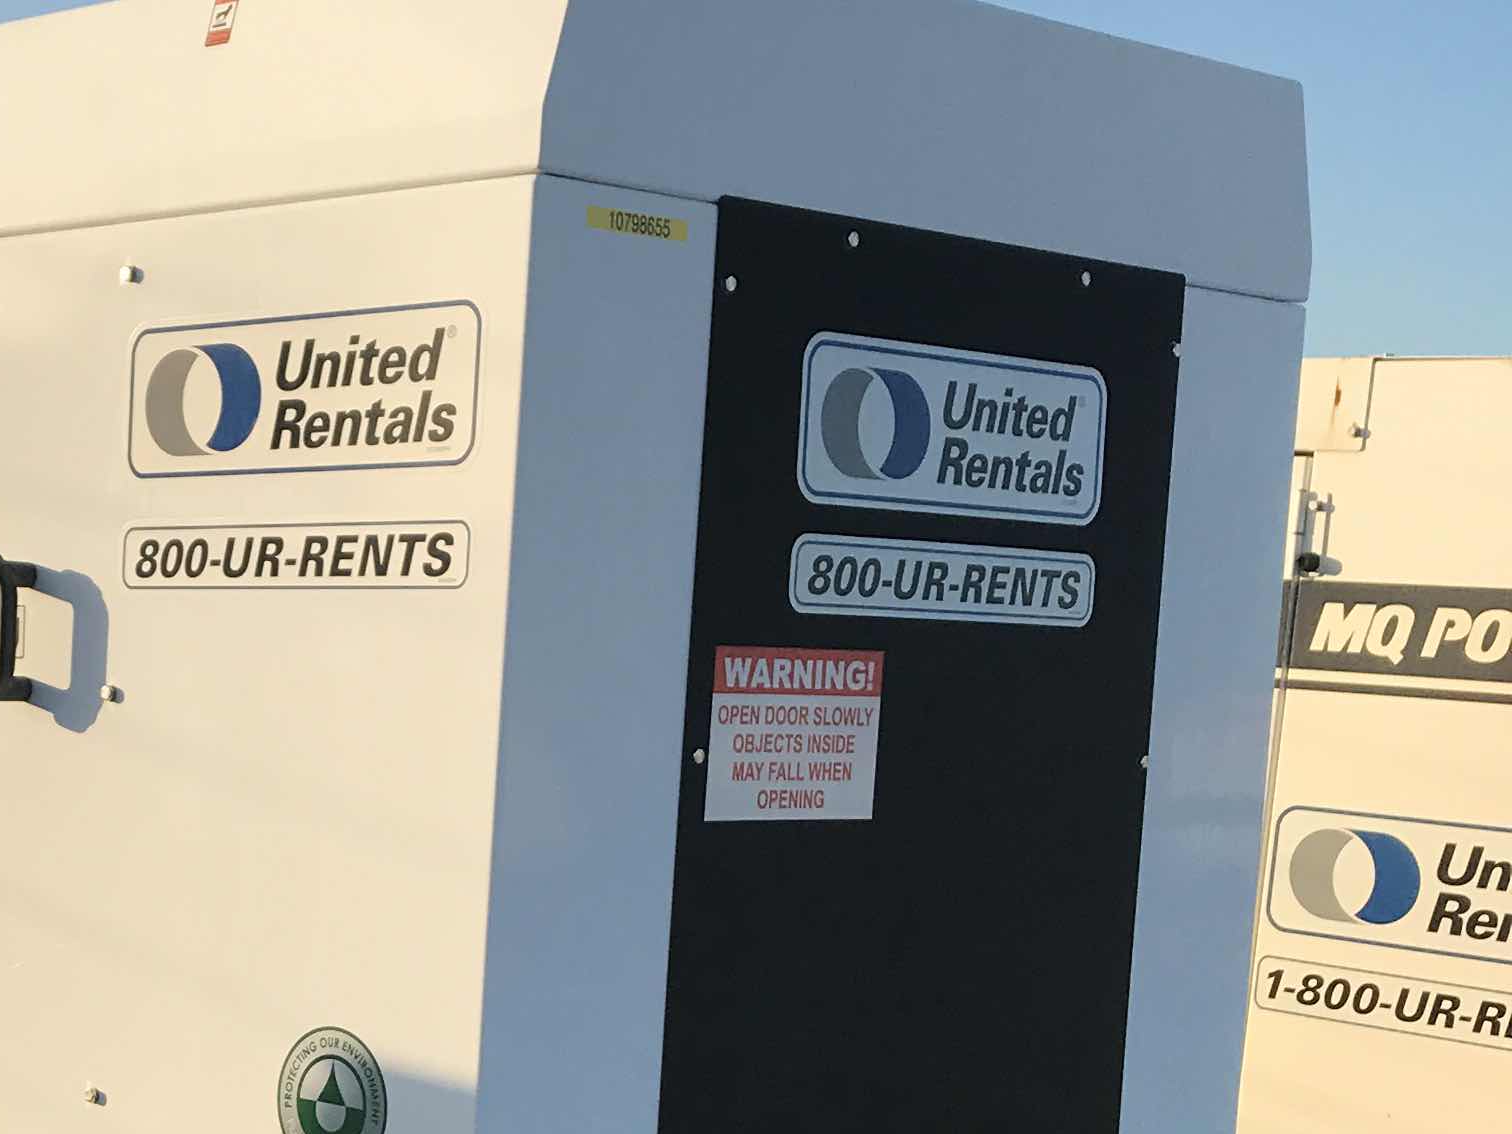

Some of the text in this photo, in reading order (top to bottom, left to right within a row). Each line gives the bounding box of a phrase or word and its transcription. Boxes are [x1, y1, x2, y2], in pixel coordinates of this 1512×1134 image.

[609, 211, 671, 239] 10798655
[275, 327, 446, 392] United
[269, 390, 457, 450] Rentals
[942, 380, 1077, 442] United
[936, 437, 1083, 497] Rentals
[134, 531, 455, 579] 800-UR-RENTS
[806, 554, 1081, 610] 800-UR-RENTS
[1308, 601, 1416, 667] MQ
[724, 656, 875, 691] WARNING!
[718, 704, 874, 727] OPEN DOOR SLOWLY
[732, 733, 856, 754] OBJECTS INSIDE
[731, 761, 852, 781] MAY FALL WHEN
[756, 789, 825, 810] OPENING
[1437, 842, 1512, 892] Un
[284, 1041, 318, 1109] PROTECTING
[319, 1036, 340, 1049] OUR
